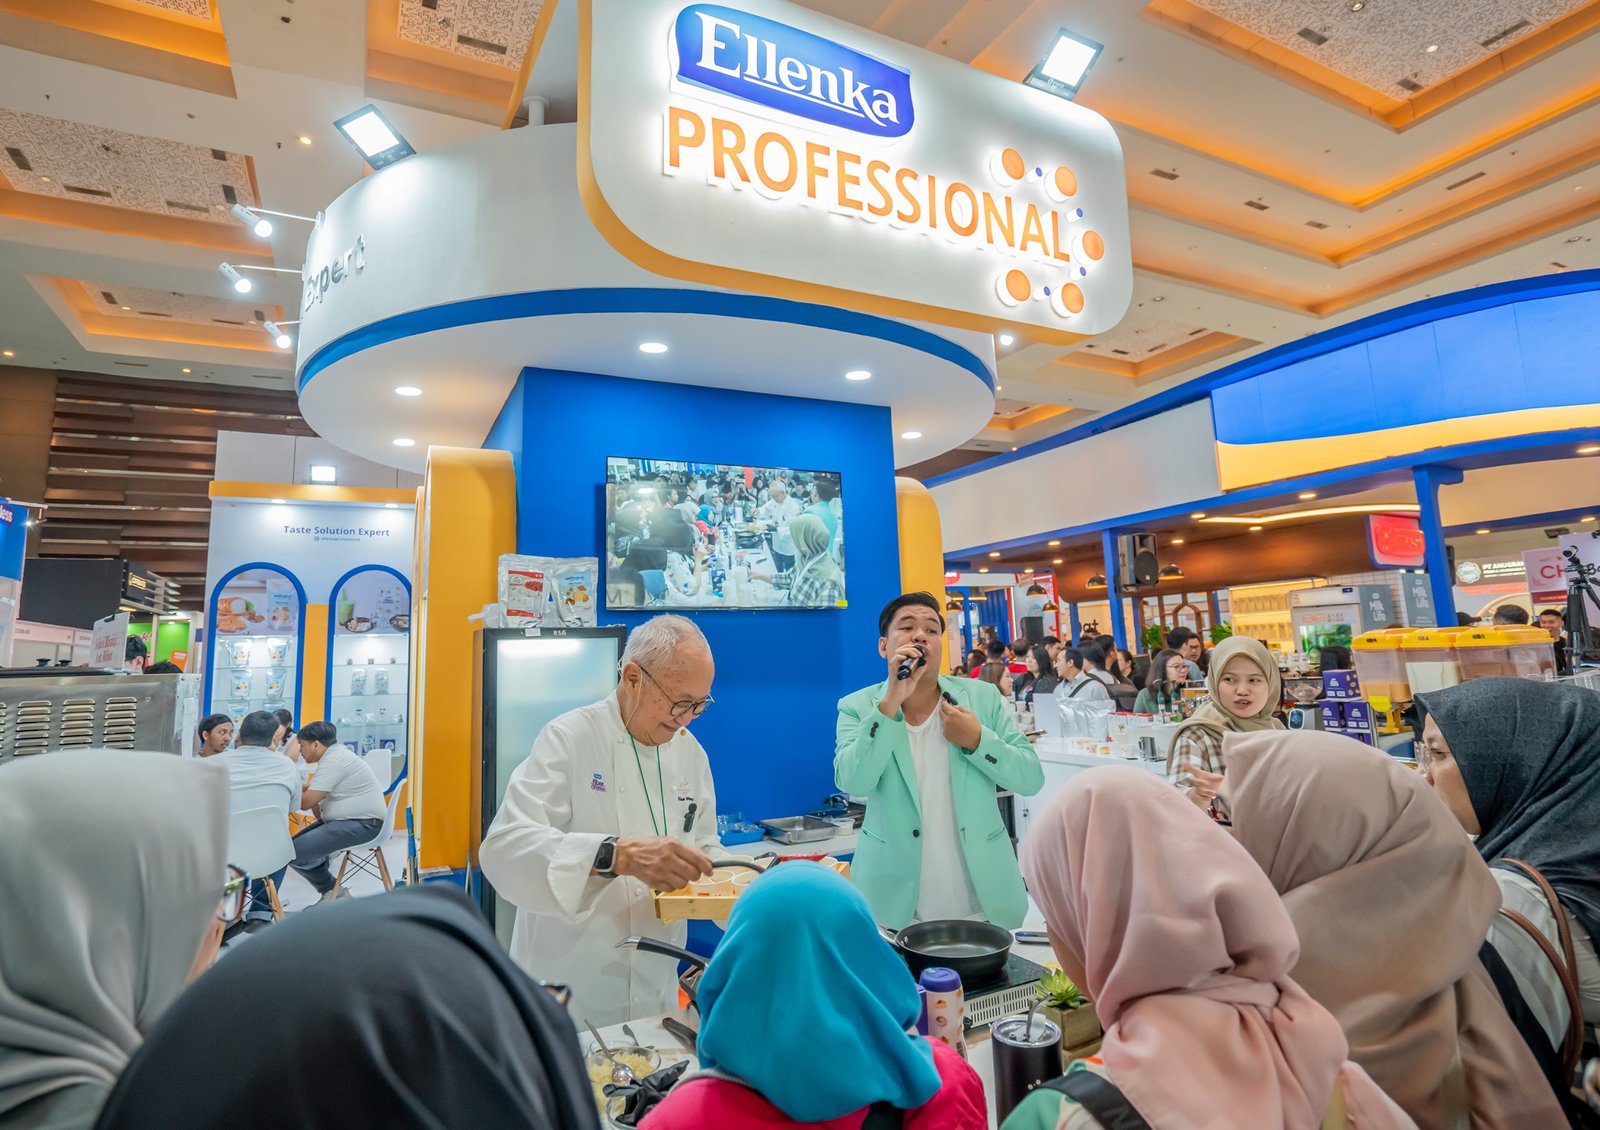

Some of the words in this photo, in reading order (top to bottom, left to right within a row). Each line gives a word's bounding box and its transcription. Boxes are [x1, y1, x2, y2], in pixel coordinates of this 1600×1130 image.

[695, 10, 900, 127] Ellenka
[669, 106, 1070, 263] PROFESSIONAL
[283, 525, 312, 534] Taste
[314, 526, 356, 535] Solution
[358, 527, 390, 538] Expert
